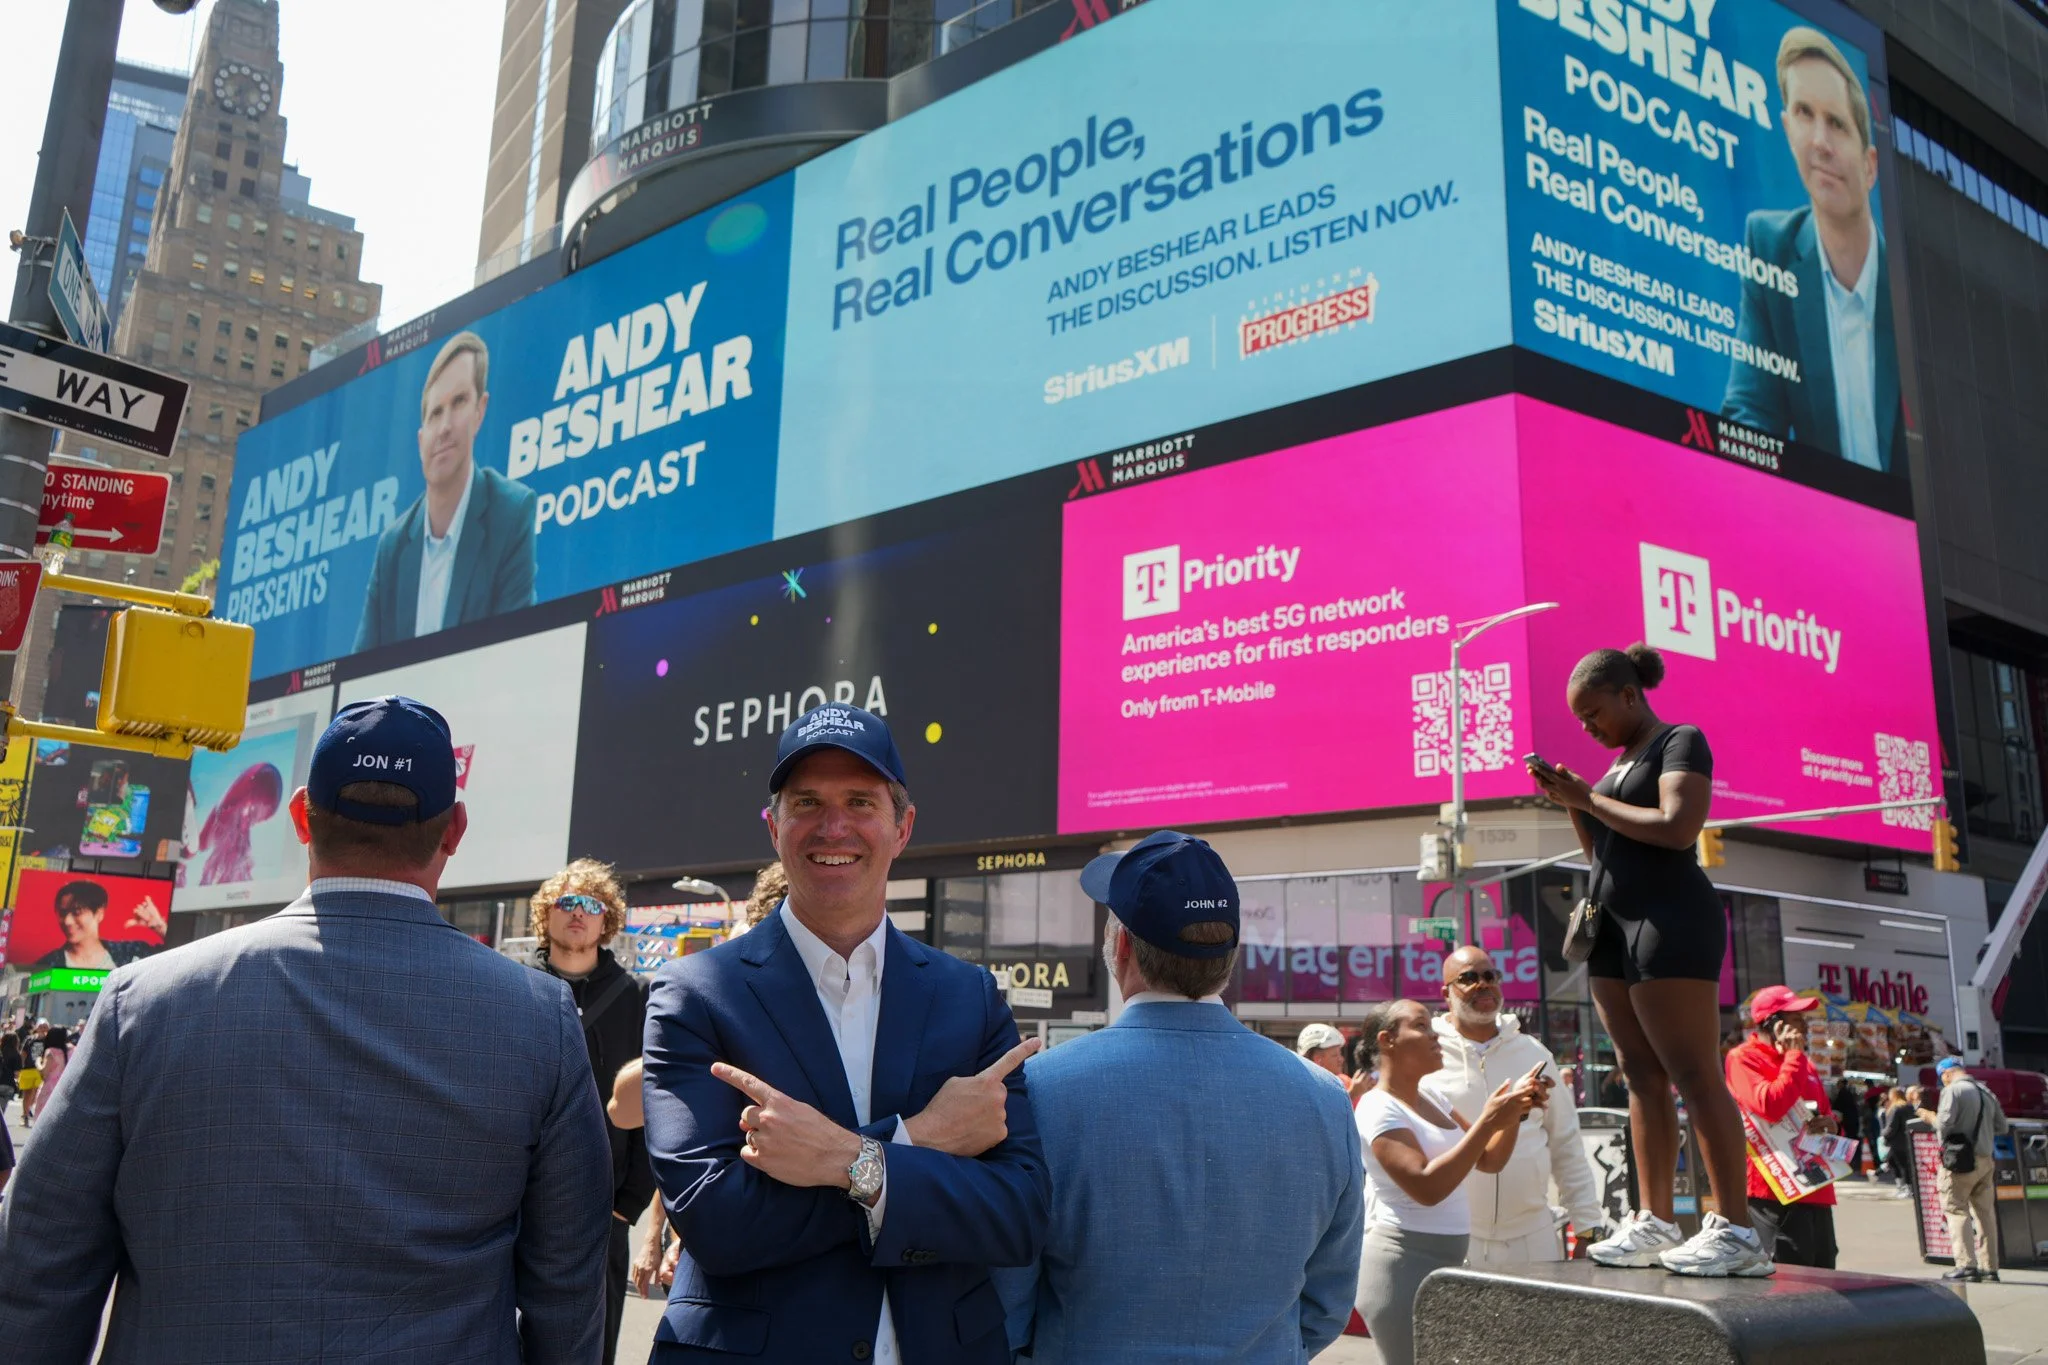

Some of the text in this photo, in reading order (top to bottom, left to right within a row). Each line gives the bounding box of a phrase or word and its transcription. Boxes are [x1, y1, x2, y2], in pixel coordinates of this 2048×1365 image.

[620, 104, 712, 154] MARRIOTT
[1564, 54, 1739, 169] PODCAST
[618, 128, 698, 174] MARQUIS
[1524, 105, 1704, 222] Real People,
[832, 88, 1384, 331] Real Conversations
[836, 114, 1145, 271] Real People,
[1047, 183, 1336, 304] ANDY BESHEAR LEADS
[1526, 152, 1798, 298] Real Conversations
[1046, 180, 1460, 336] THE DISCUSSION. LISTEN NOW.
[1531, 232, 1735, 330] ANDY BESHEAR LEADS
[64, 258, 83, 317] ONE
[385, 331, 429, 360] MARQUIS
[387, 312, 437, 344] MARRIOTT
[552, 280, 708, 402] ANDY
[1043, 288, 1368, 405] SiriusXM PROGRESS
[1532, 262, 1801, 382] THE DISCUSSION. LISTEN NOW.
[1534, 298, 1676, 376] SiriusXM
[56, 368, 146, 419] WAY
[507, 335, 753, 480] BESHEAR
[1112, 434, 1196, 468] MARRIOTT
[1718, 420, 1784, 454] MARRIOTT
[1719, 438, 1778, 470] MARQUIS
[44, 472, 134, 495] O STANDING
[238, 440, 340, 530] ANDY
[534, 440, 706, 535] PODCAST
[1112, 454, 1185, 484] MARQUIS
[42, 492, 94, 510] nytime
[231, 476, 399, 585] BESHEAR
[226, 560, 329, 624] PRESENTS
[622, 572, 672, 595] MARRIOTT
[1184, 544, 1300, 593] Priority
[620, 586, 664, 608] MARQUIS
[1122, 586, 1406, 656] America's best 5G network
[1121, 615, 1450, 684] experience for first responders
[1717, 587, 1841, 674] Priority
[810, 708, 850, 724] ANDY
[1121, 680, 1276, 719] Only from T-Mobile
[798, 716, 866, 738] BESHEAR
[806, 728, 854, 742] PODCAST
[352, 754, 412, 772] JON #1
[1801, 747, 1864, 772] Discover more
[977, 852, 1046, 870] SEPHORA
[1184, 899, 1228, 908] JOHN #2
[1847, 966, 1929, 1016] Mobile
